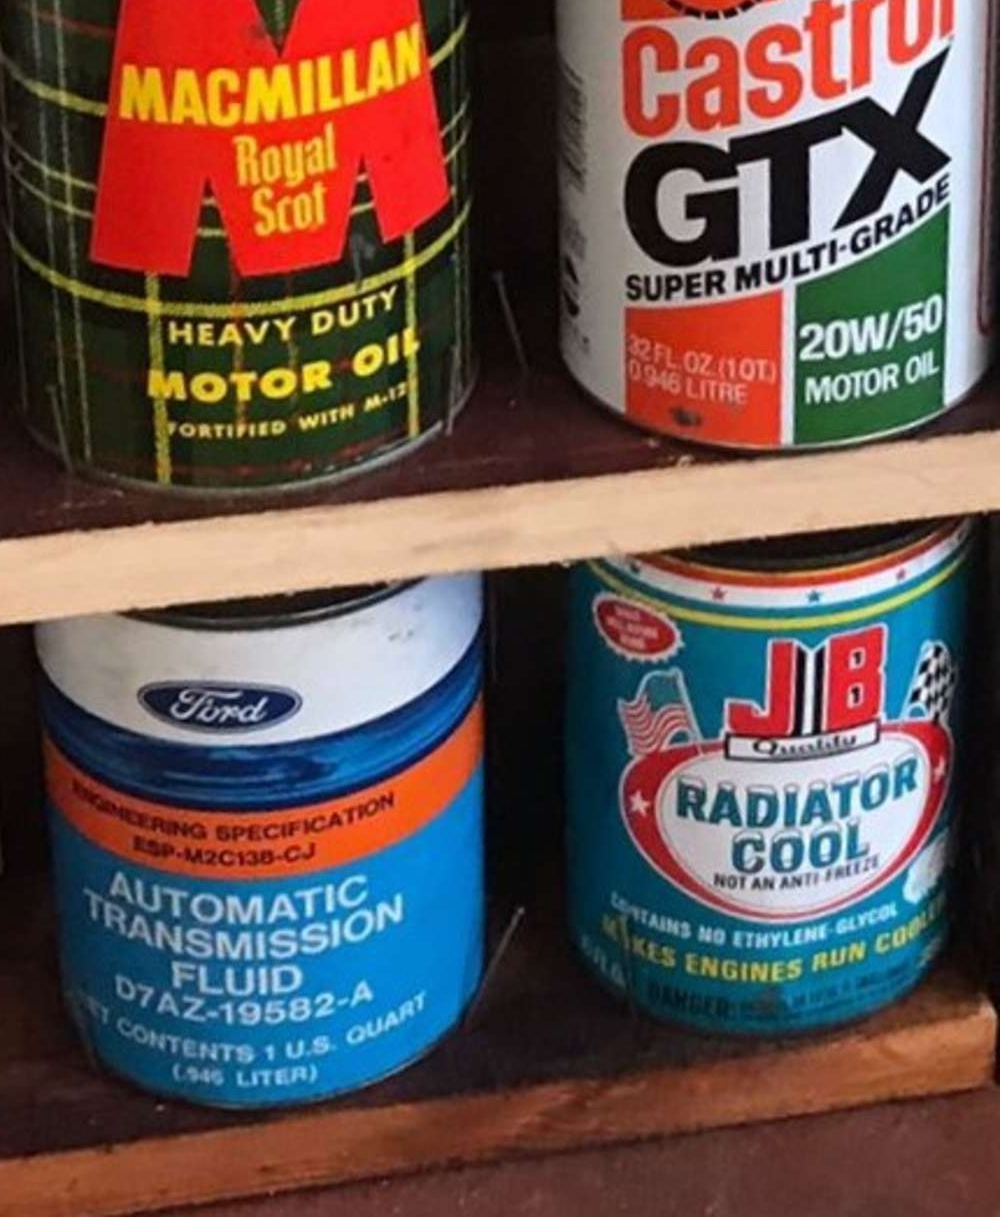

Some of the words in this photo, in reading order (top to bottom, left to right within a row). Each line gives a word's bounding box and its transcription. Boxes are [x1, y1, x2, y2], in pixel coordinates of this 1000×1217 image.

[119, 22, 423, 128] MACMILLAN
[232, 121, 338, 190] Royal
[624, 45, 953, 269] GTX
[251, 182, 327, 238] Scot
[626, 268, 728, 302] SUPER
[734, 171, 952, 293] MULTI-GRADE
[167, 315, 297, 346] HEAVY
[311, 284, 399, 337] DUTY
[798, 292, 943, 362] 20W/50
[147, 359, 333, 404] MOTOR
[352, 326, 422, 377] OIL
[685, 376, 749, 405] LITRE
[804, 365, 900, 405] MOTOR
[905, 350, 941, 384] OIL
[165, 420, 287, 439] FORTIFIED
[298, 402, 356, 432] WITH
[169, 684, 268, 724] Ford
[71, 778, 207, 842] ENGINEERING
[216, 791, 396, 844] SPECIFICATION
[675, 755, 920, 829] RADIATOR
[731, 821, 870, 875] COOL
[108, 870, 369, 926] AUTOMATIC
[713, 873, 747, 890] NOT
[751, 876, 775, 891] AN
[82, 892, 404, 961] TRANSMISSION
[610, 890, 692, 940] CONTAINS
[698, 928, 726, 946] NO
[170, 961, 303, 996] FLUID
[685, 953, 803, 983] ENGINES
[811, 940, 867, 973] RUN
[114, 975, 375, 1026] D7AZ-19582-A
[116, 1019, 255, 1064] CONTENTS
[286, 1034, 336, 1060] U.S.
[345, 990, 428, 1045] QUART
[235, 1063, 319, 1087] LITER)
